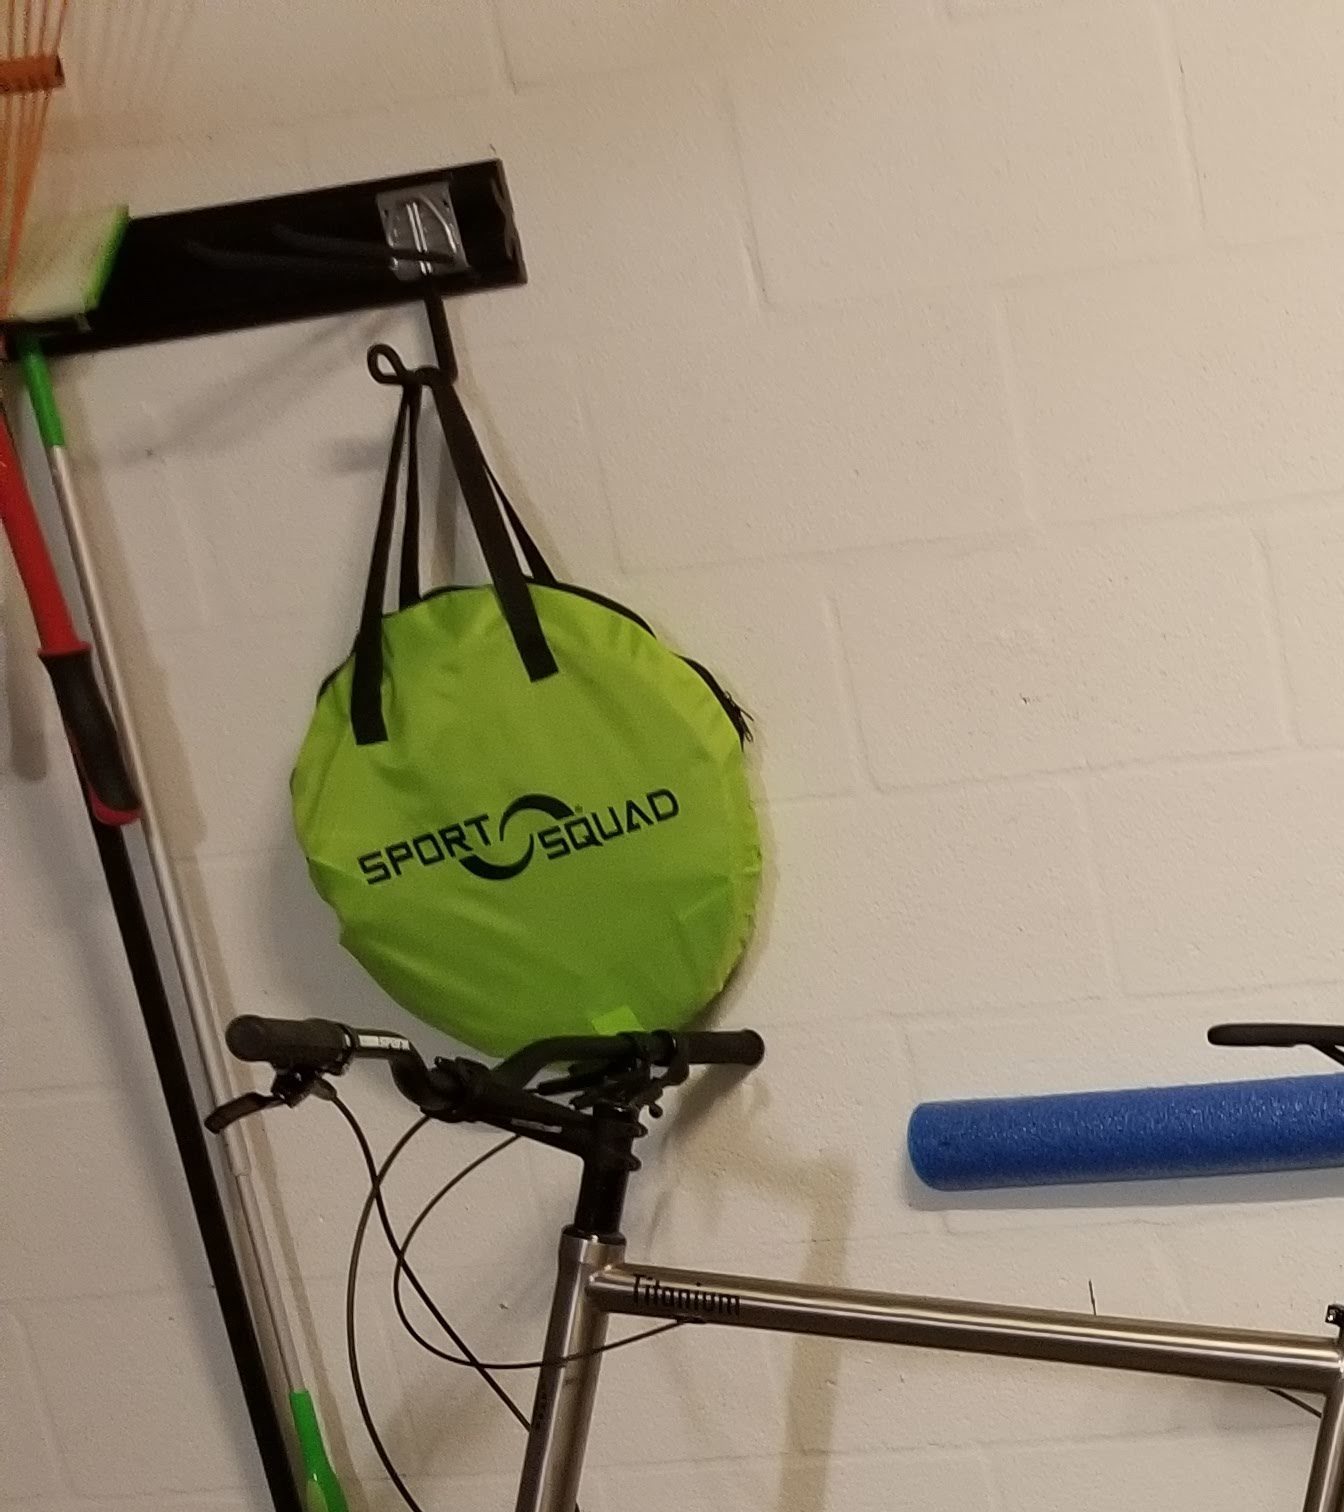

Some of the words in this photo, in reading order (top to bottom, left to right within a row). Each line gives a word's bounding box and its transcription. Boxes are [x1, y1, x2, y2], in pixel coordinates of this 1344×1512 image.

[357, 813, 491, 885] SPORT
[538, 788, 680, 860] SQUAD
[631, 1273, 741, 1316] Titanium
